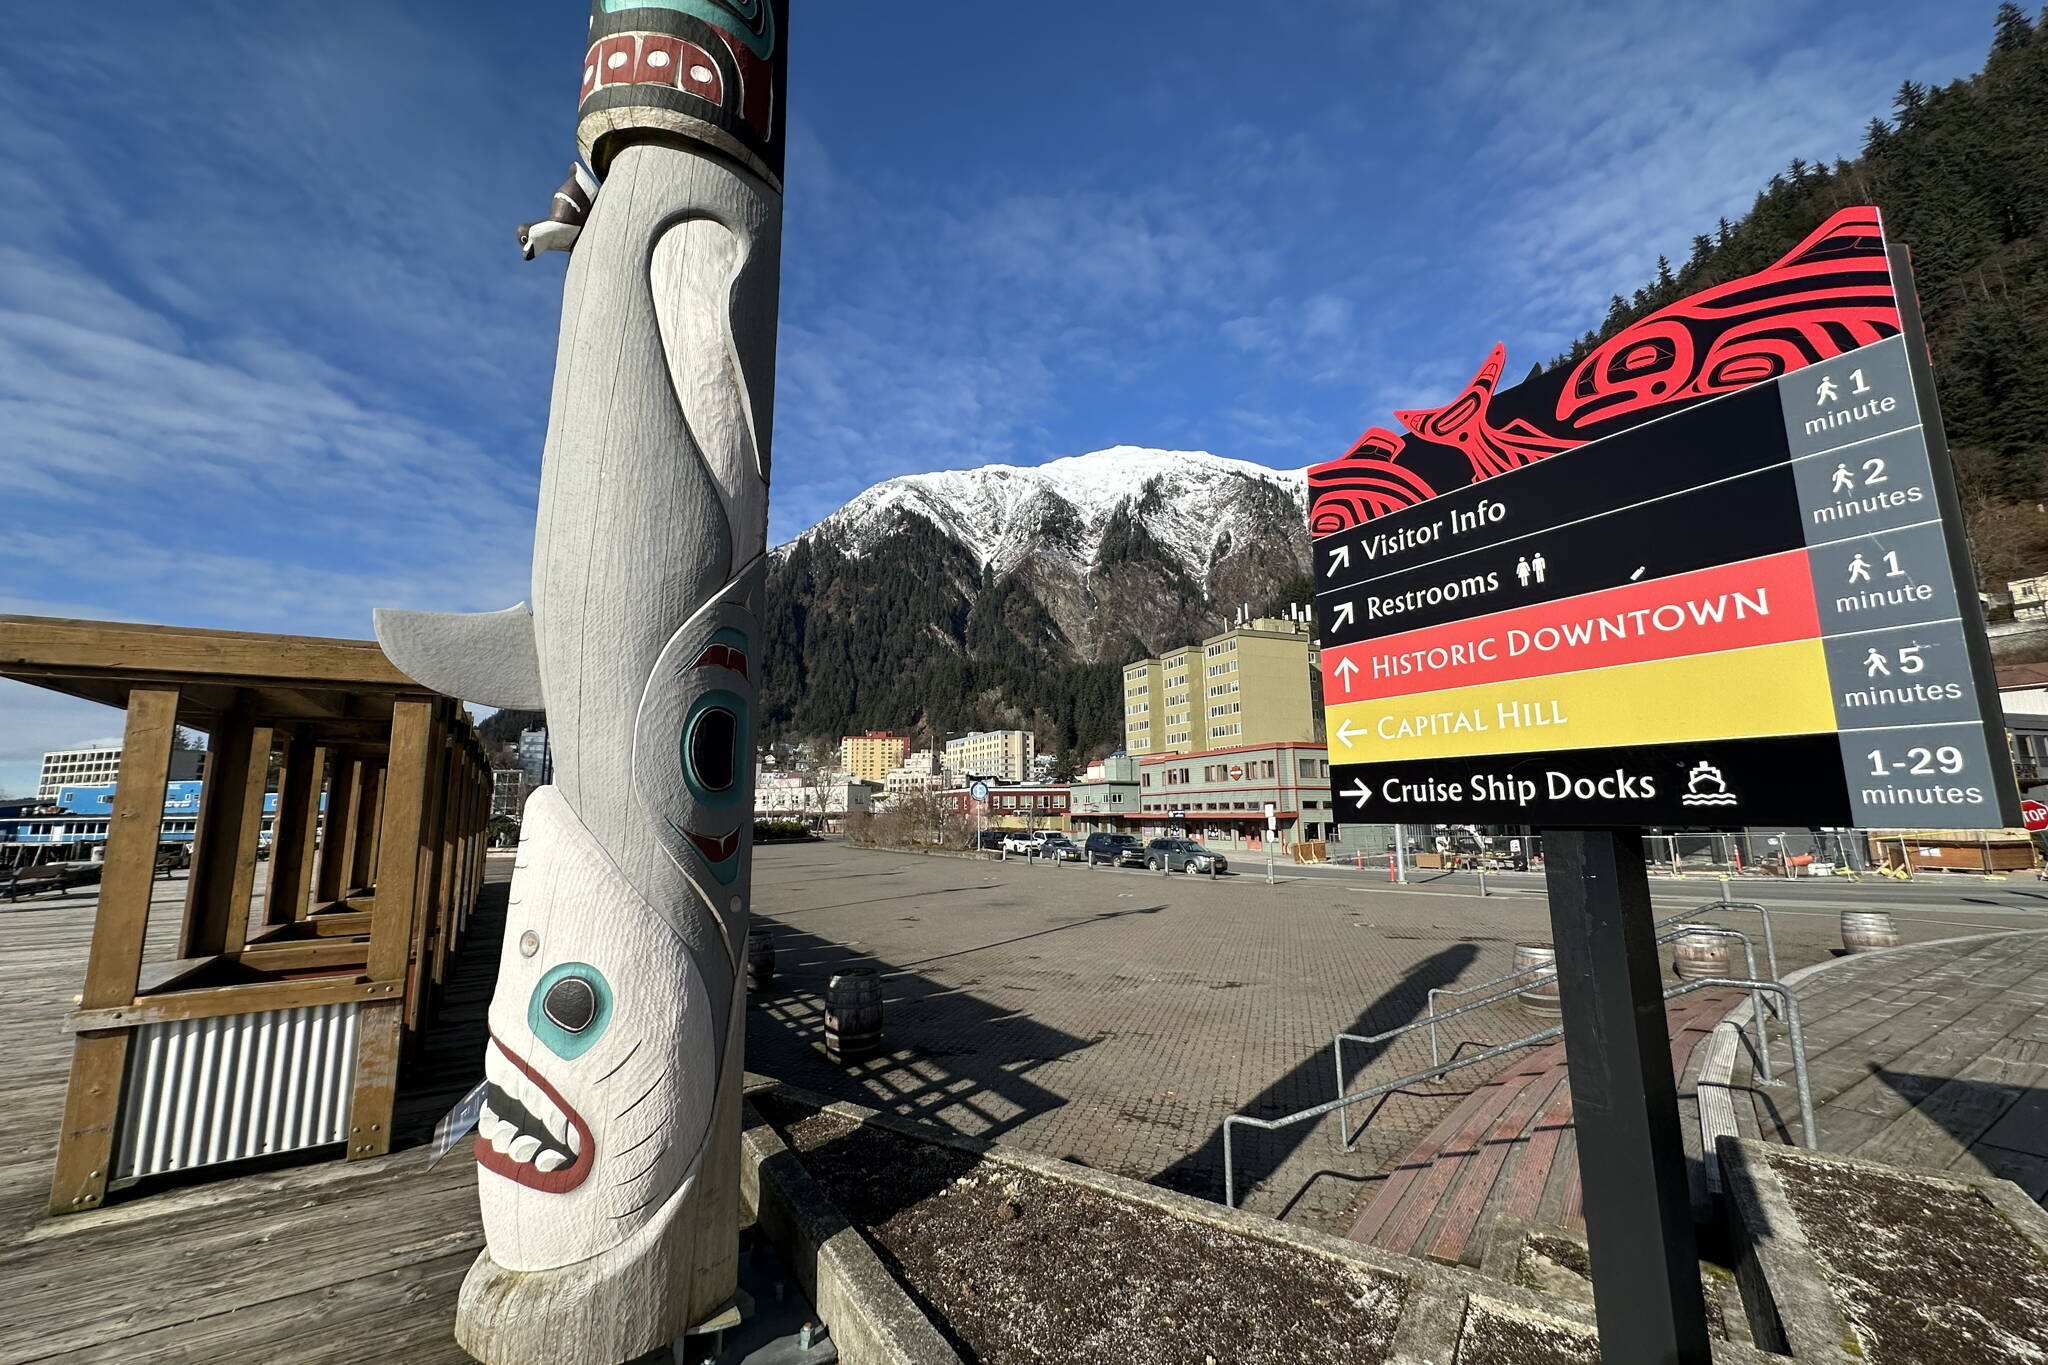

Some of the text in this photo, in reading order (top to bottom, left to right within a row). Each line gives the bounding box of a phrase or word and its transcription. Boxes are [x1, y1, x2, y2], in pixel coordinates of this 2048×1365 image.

[1849, 368, 1871, 395] 1
[1804, 396, 1896, 436] minute
[1862, 458, 1888, 485] 2
[1813, 486, 1923, 524] minutes
[1360, 499, 1506, 560] Visitor Info
[1883, 551, 1905, 577] 1
[1366, 571, 1499, 620] Restrooms
[1836, 583, 1933, 613] minute
[1371, 587, 1771, 679] HISTORIC DOWNTOWN
[1898, 646, 1924, 674] 5
[1844, 682, 1962, 707] minutes
[1376, 700, 1568, 741] CAPITAL HILL
[1867, 746, 1963, 776] 1-29
[1382, 768, 1656, 806] Cruise Ship Docks
[1861, 785, 1983, 805] minutes
[2022, 808, 2047, 823] TOP
